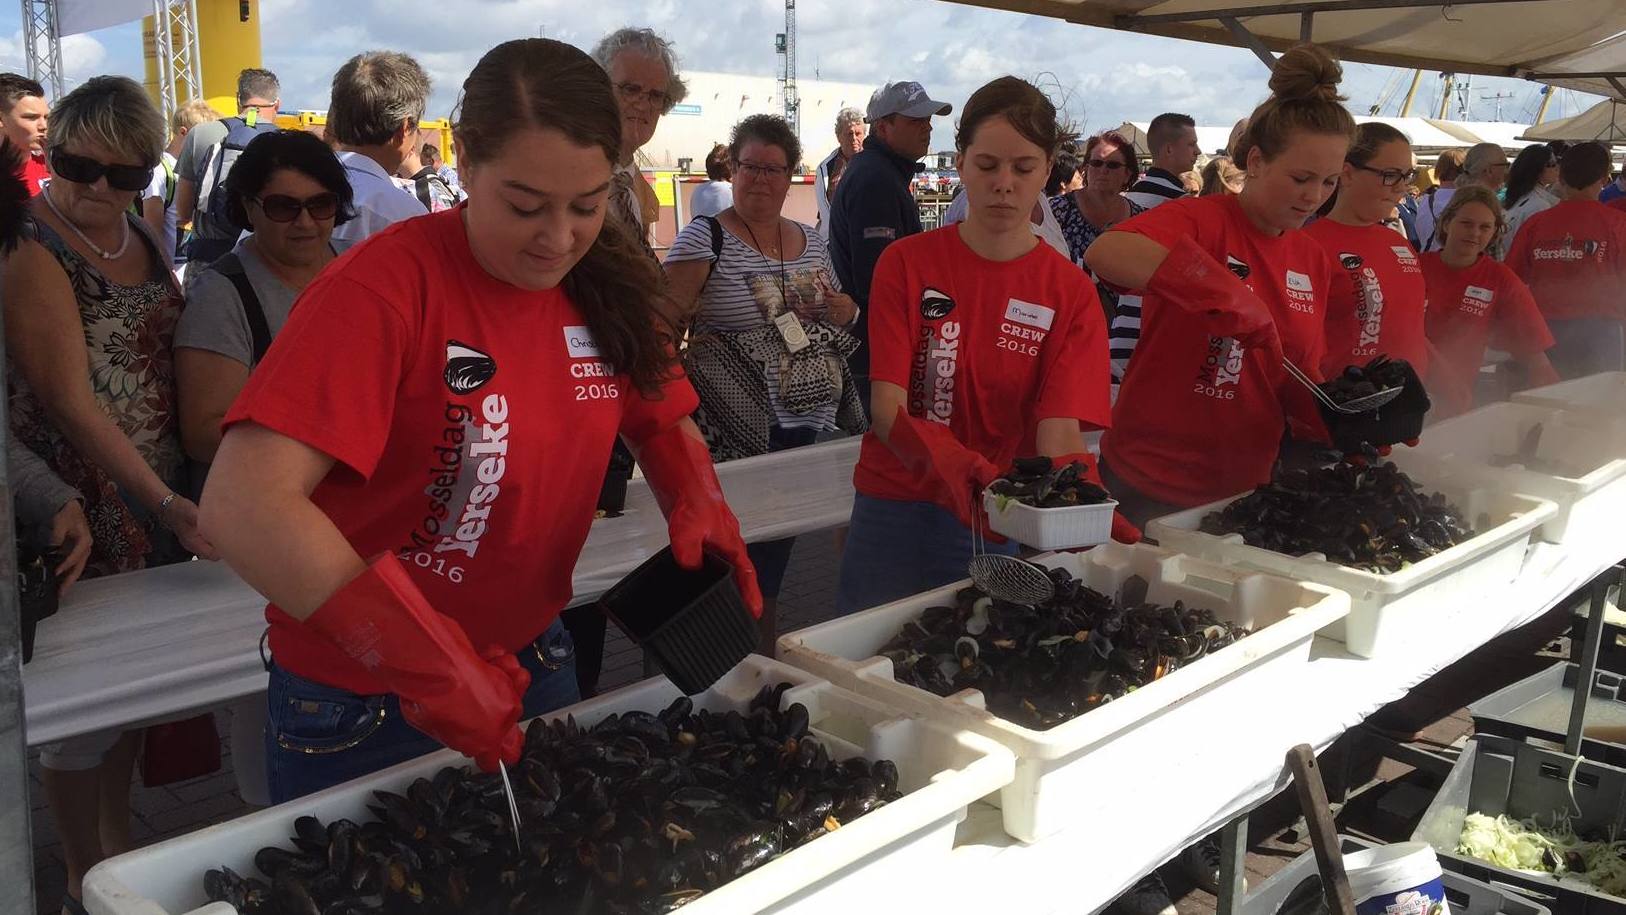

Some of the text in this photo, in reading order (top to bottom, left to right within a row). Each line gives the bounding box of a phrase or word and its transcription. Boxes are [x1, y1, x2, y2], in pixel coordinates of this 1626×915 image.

[1286, 289, 1313, 301] CREW
[1288, 300, 1313, 314] 2016
[1360, 268, 1383, 347] Yerseke
[1001, 323, 1045, 342] CREW
[996, 337, 1039, 357] 2016
[1352, 348, 1376, 356] 016
[571, 362, 615, 378] CREW
[909, 325, 935, 417] osseldag
[575, 384, 618, 400] 2016
[1194, 384, 1235, 399] 2016
[400, 401, 474, 553] Mosseldag
[433, 393, 510, 559] Yerseke
